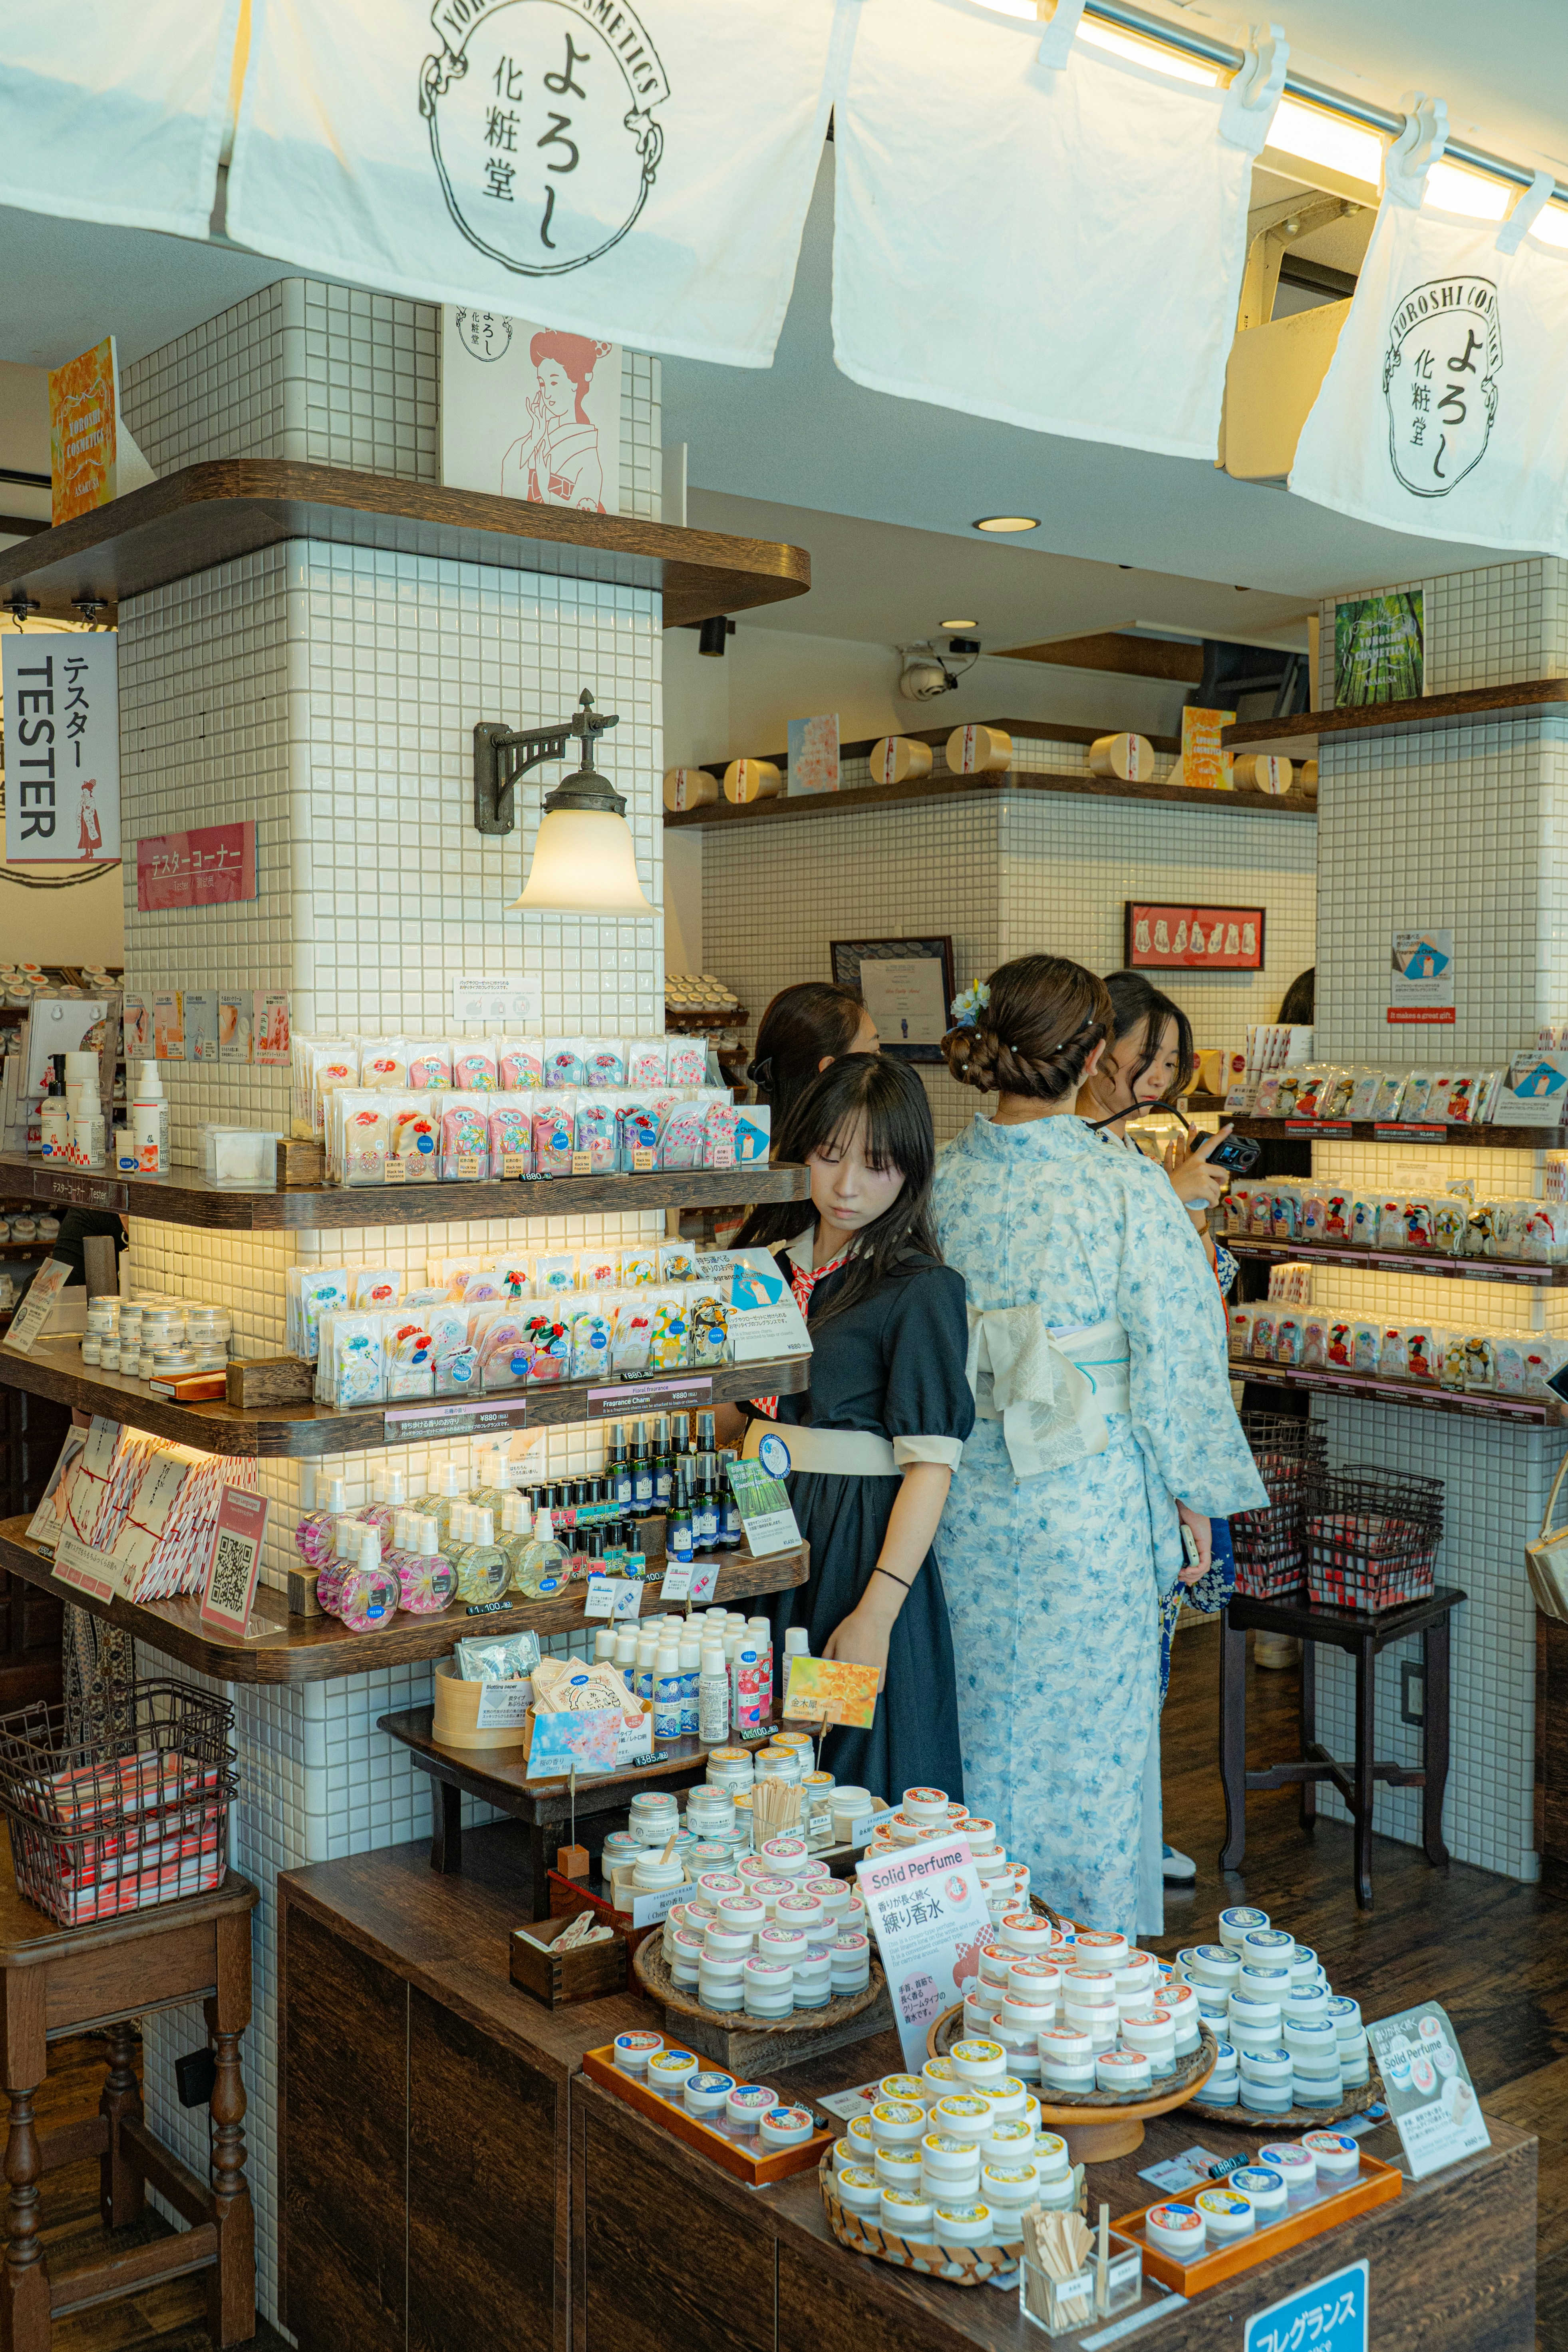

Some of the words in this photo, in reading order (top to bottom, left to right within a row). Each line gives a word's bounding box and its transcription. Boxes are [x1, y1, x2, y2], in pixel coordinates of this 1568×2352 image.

[483, 56, 523, 201] 化粧堂
[1393, 286, 1463, 338] YOROSHI
[471, 312, 480, 345] 化粧堂
[1410, 349, 1435, 446] 化粧堂
[70, 408, 101, 437] YOROSHI
[66, 429, 104, 459] COSMETICS
[74, 478, 99, 497] ASAKUSA
[1359, 634, 1401, 647] YOROSHI
[1355, 644, 1405, 661] COSMETICS
[1364, 675, 1397, 687] ASAKUSA
[64, 657, 89, 767] テスター
[18, 656, 56, 841] TESTER
[152, 844, 240, 877] テスターコーナー
[174, 881, 189, 891] Tester
[1439, 1012, 1453, 1020] gift.
[53, 1182, 85, 1195] テスターコーナー
[90, 1188, 107, 1200] Tester
[696, 1255, 730, 1264] 持ち運べる
[701, 1263, 739, 1273] 香りのお守り
[603, 1398, 631, 1408] Fragrance
[401, 1418, 459, 1430] 持ち歩ける香りのお守り
[736, 1481, 755, 1490] Sleeping
[229, 1494, 240, 1503] Foreign
[240, 1497, 258, 1509] Languages
[791, 1698, 817, 1709] 金木犀
[540, 1758, 564, 1767] 桜の香り
[872, 1865, 906, 1889] Solid
[908, 1851, 963, 1879] Perfume
[660, 1897, 683, 1908] 桜の香り
[878, 1887, 931, 1913] 香りが長く続く
[882, 1898, 944, 1934] 練り香水
[887, 1939, 898, 1948] This
[909, 1929, 935, 1941] cream-type
[935, 1921, 956, 1933] perfume
[890, 1946, 899, 1955] that
[900, 1939, 917, 1952] lingers
[918, 1936, 928, 1945] long
[944, 1927, 959, 1937] wrists
[969, 1919, 982, 1929] neck.
[906, 1943, 932, 1956] convenient
[932, 1937, 951, 1950] compact
[952, 1932, 963, 1942] type
[897, 1952, 920, 1966] carrying
[921, 1947, 940, 1957] around.
[898, 1975, 933, 1994] 手首、首筋で
[901, 1990, 924, 2005] 長く香る
[902, 1991, 946, 2014] クリームタイプの
[905, 2009, 932, 2024] 香水です。
[1384, 2051, 1406, 2070] Solid
[1407, 2040, 1442, 2060] Perfume
